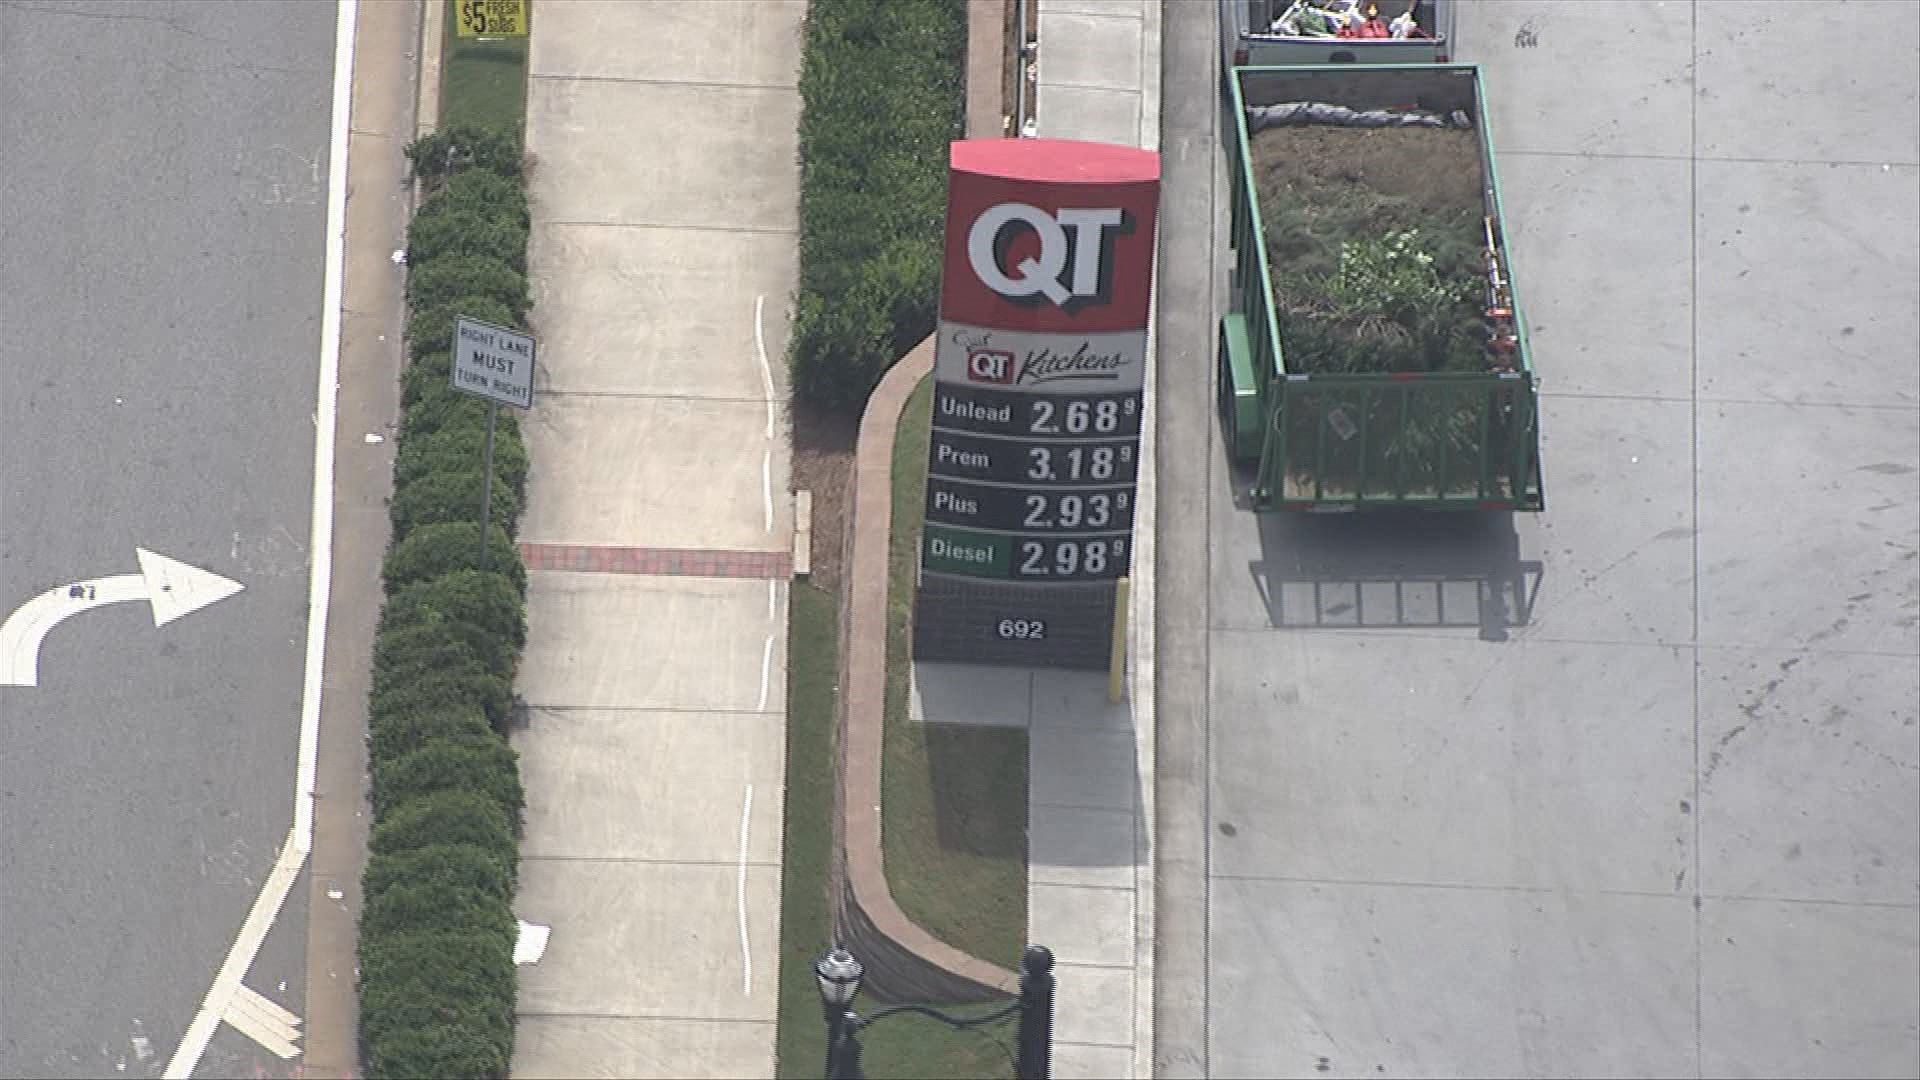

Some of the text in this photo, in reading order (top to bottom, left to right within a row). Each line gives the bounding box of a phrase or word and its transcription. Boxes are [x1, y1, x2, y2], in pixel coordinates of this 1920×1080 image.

[463, 1, 487, 34] $5
[968, 202, 1123, 306] QT
[460, 327, 529, 357] RIGHT LANE
[472, 351, 514, 376] MUST
[972, 353, 1010, 378] QT
[1016, 337, 1130, 385] Kitchens
[457, 368, 528, 400] TURN RIGHT
[940, 396, 1012, 423] Unlead
[1030, 401, 1119, 433] 2.68
[938, 444, 990, 468] Prem
[1028, 447, 1114, 480] 3.18
[934, 491, 979, 514] Plus
[1023, 495, 1111, 527] 2.93
[931, 538, 994, 564] Diesel
[1020, 541, 1108, 575] 2.98
[999, 619, 1044, 639] 692
